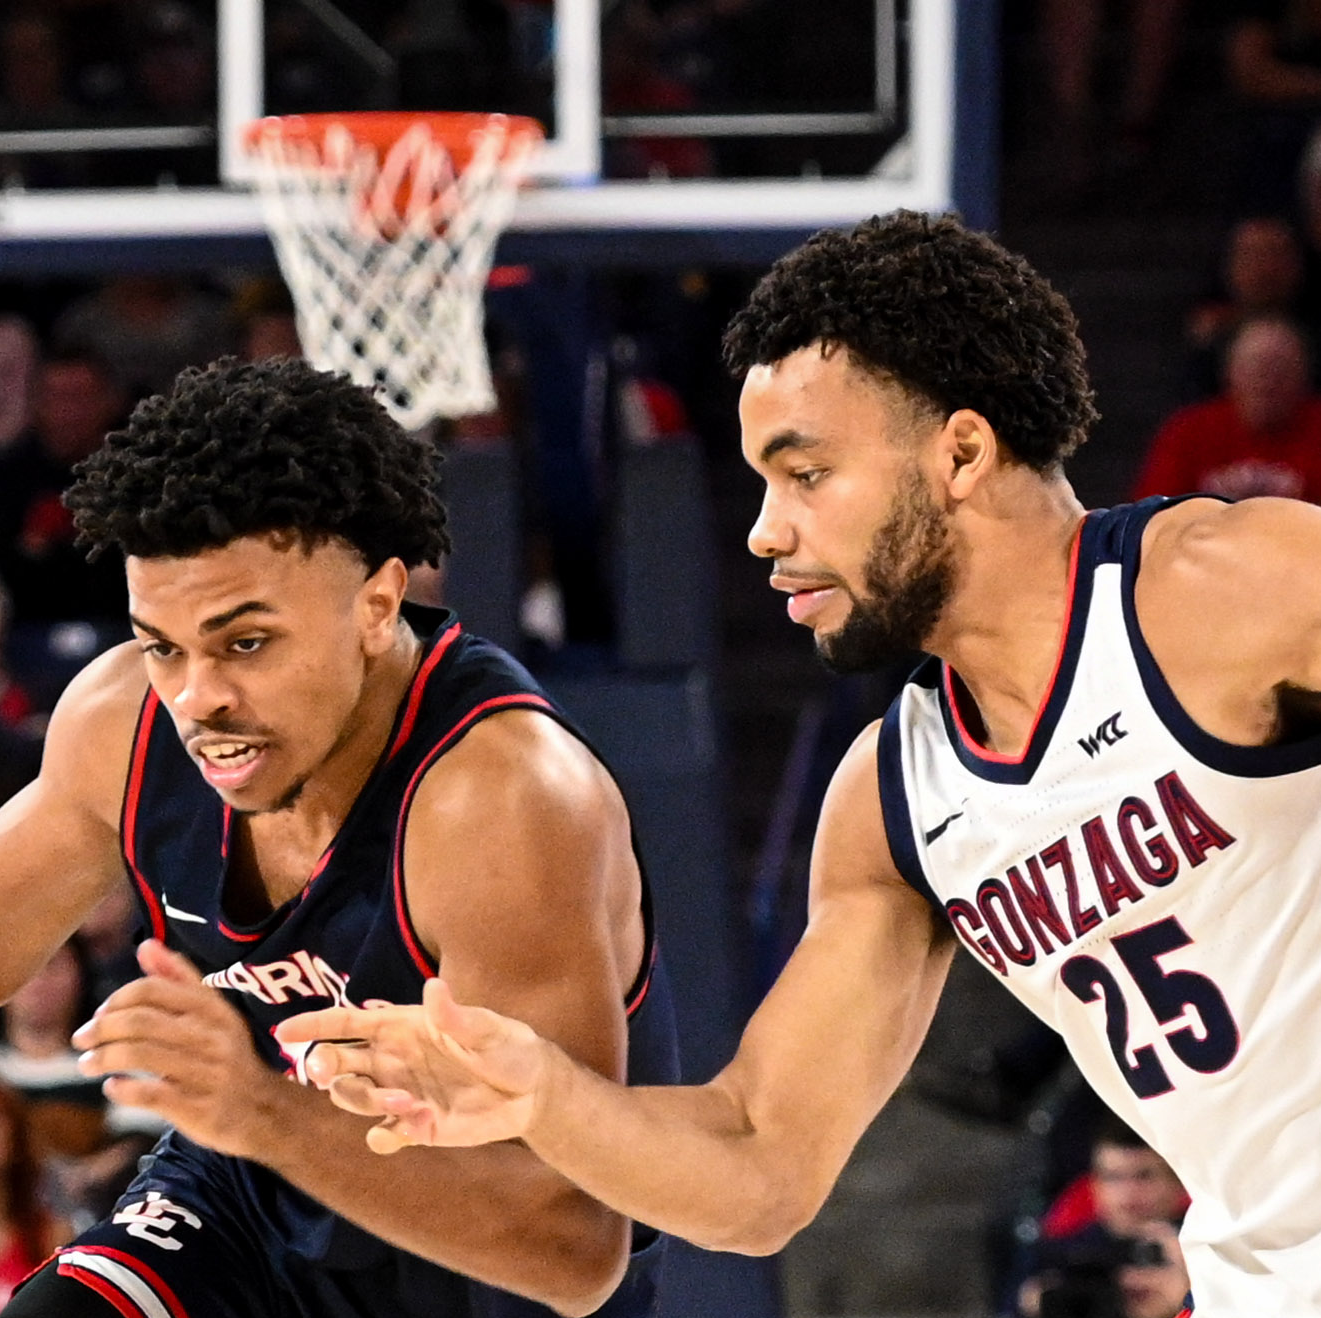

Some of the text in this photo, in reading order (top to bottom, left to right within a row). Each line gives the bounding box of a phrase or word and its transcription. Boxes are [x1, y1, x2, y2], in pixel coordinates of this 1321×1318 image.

[1077, 710, 1129, 760] WCC
[945, 769, 1237, 978] GONZAGA
[1060, 914, 1241, 1100] 25
